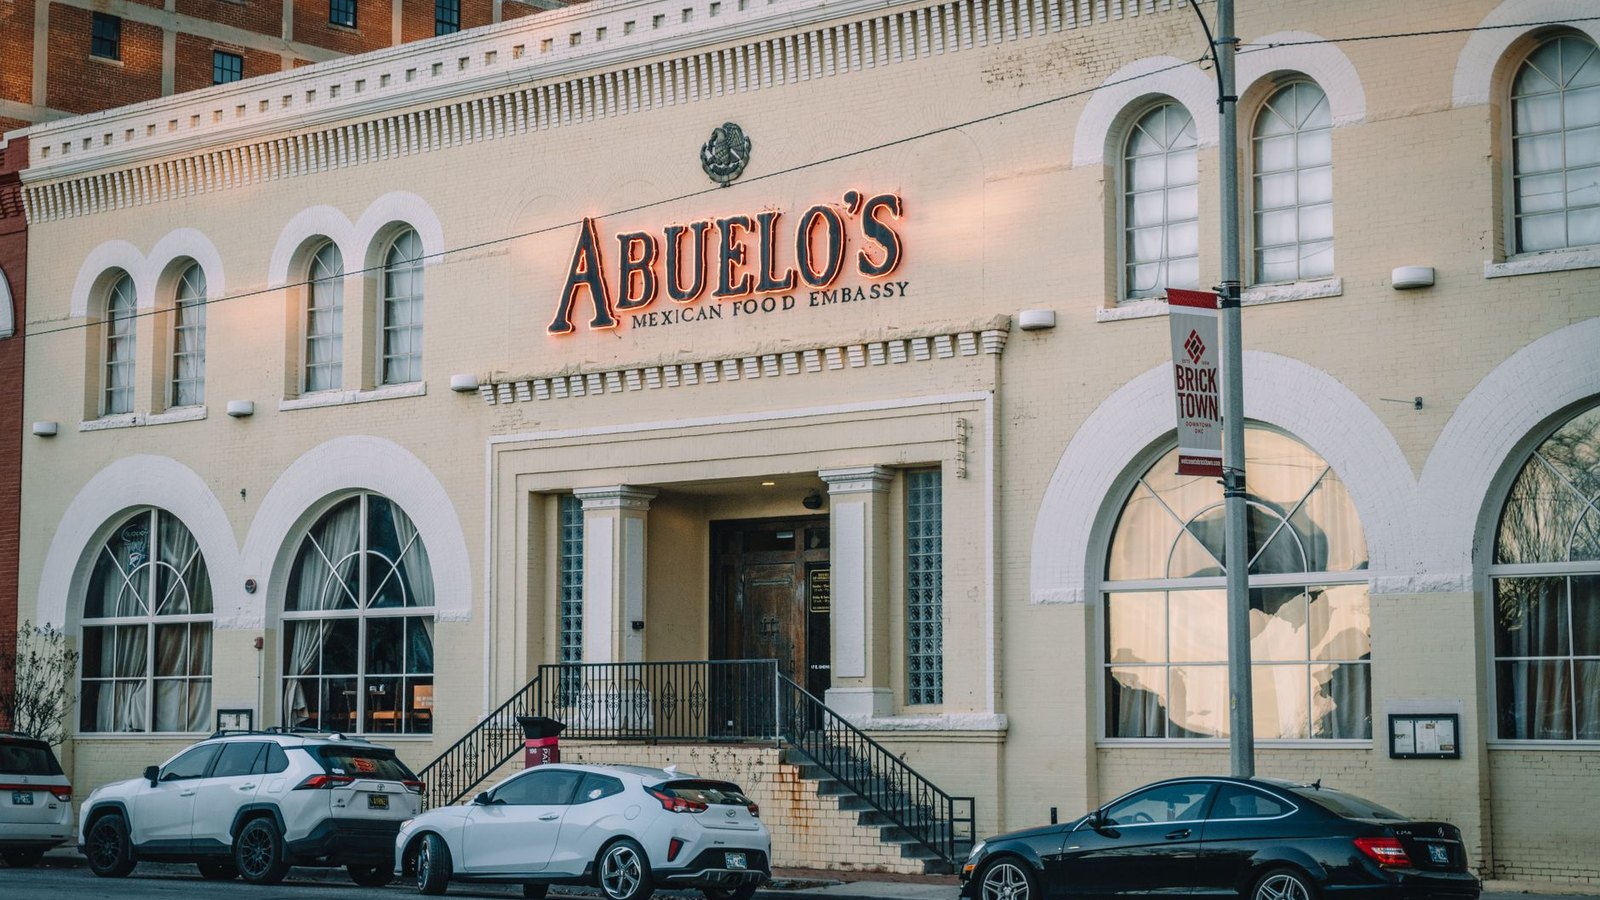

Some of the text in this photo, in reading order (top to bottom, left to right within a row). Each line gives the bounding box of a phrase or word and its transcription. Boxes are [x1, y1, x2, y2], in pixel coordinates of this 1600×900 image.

[548, 190, 903, 335] ABUELO'S
[631, 281, 910, 329] MEXICAN FOOD EMBASSY
[1175, 364, 1218, 394] BRICK
[1177, 392, 1219, 422] TOWN
